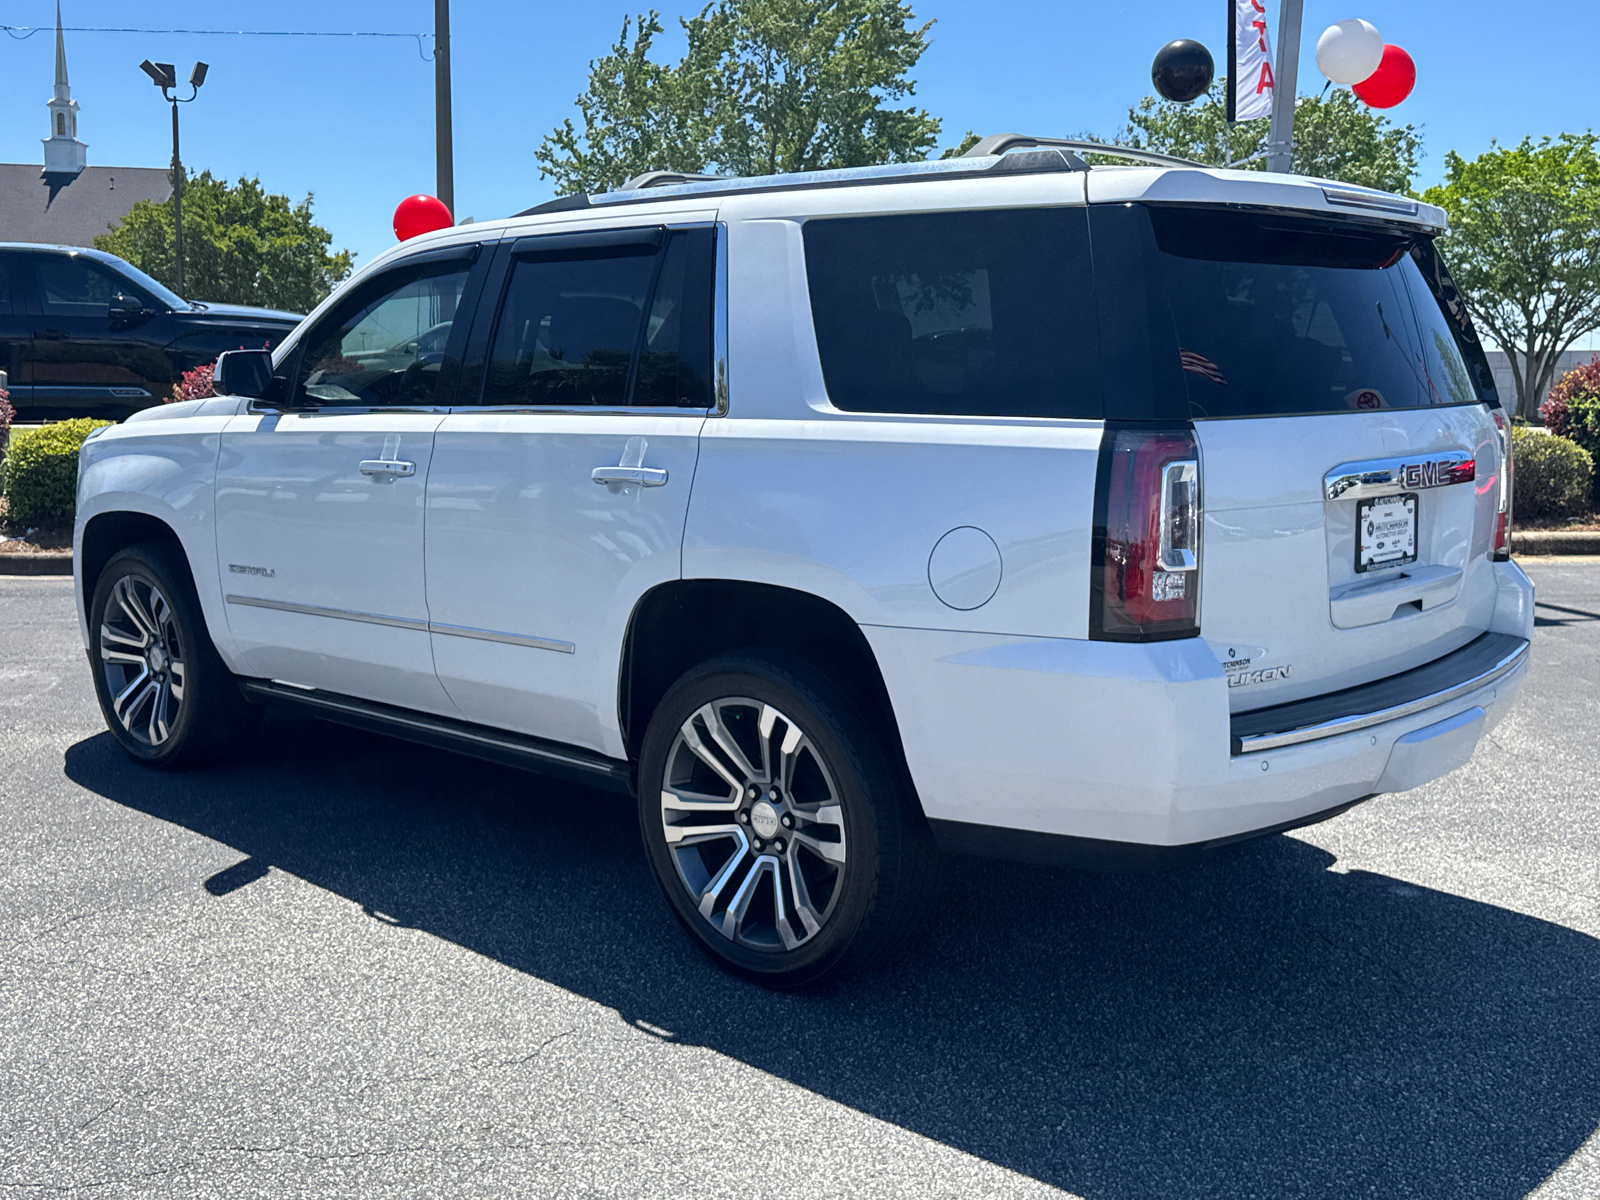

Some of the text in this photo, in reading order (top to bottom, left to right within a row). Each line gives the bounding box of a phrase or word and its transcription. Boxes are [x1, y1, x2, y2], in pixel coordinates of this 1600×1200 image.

[1405, 460, 1451, 489] GMC
[1375, 519, 1409, 533] HUTCHINSON
[228, 564, 275, 578] DENALI
[1227, 664, 1292, 688] UKON
